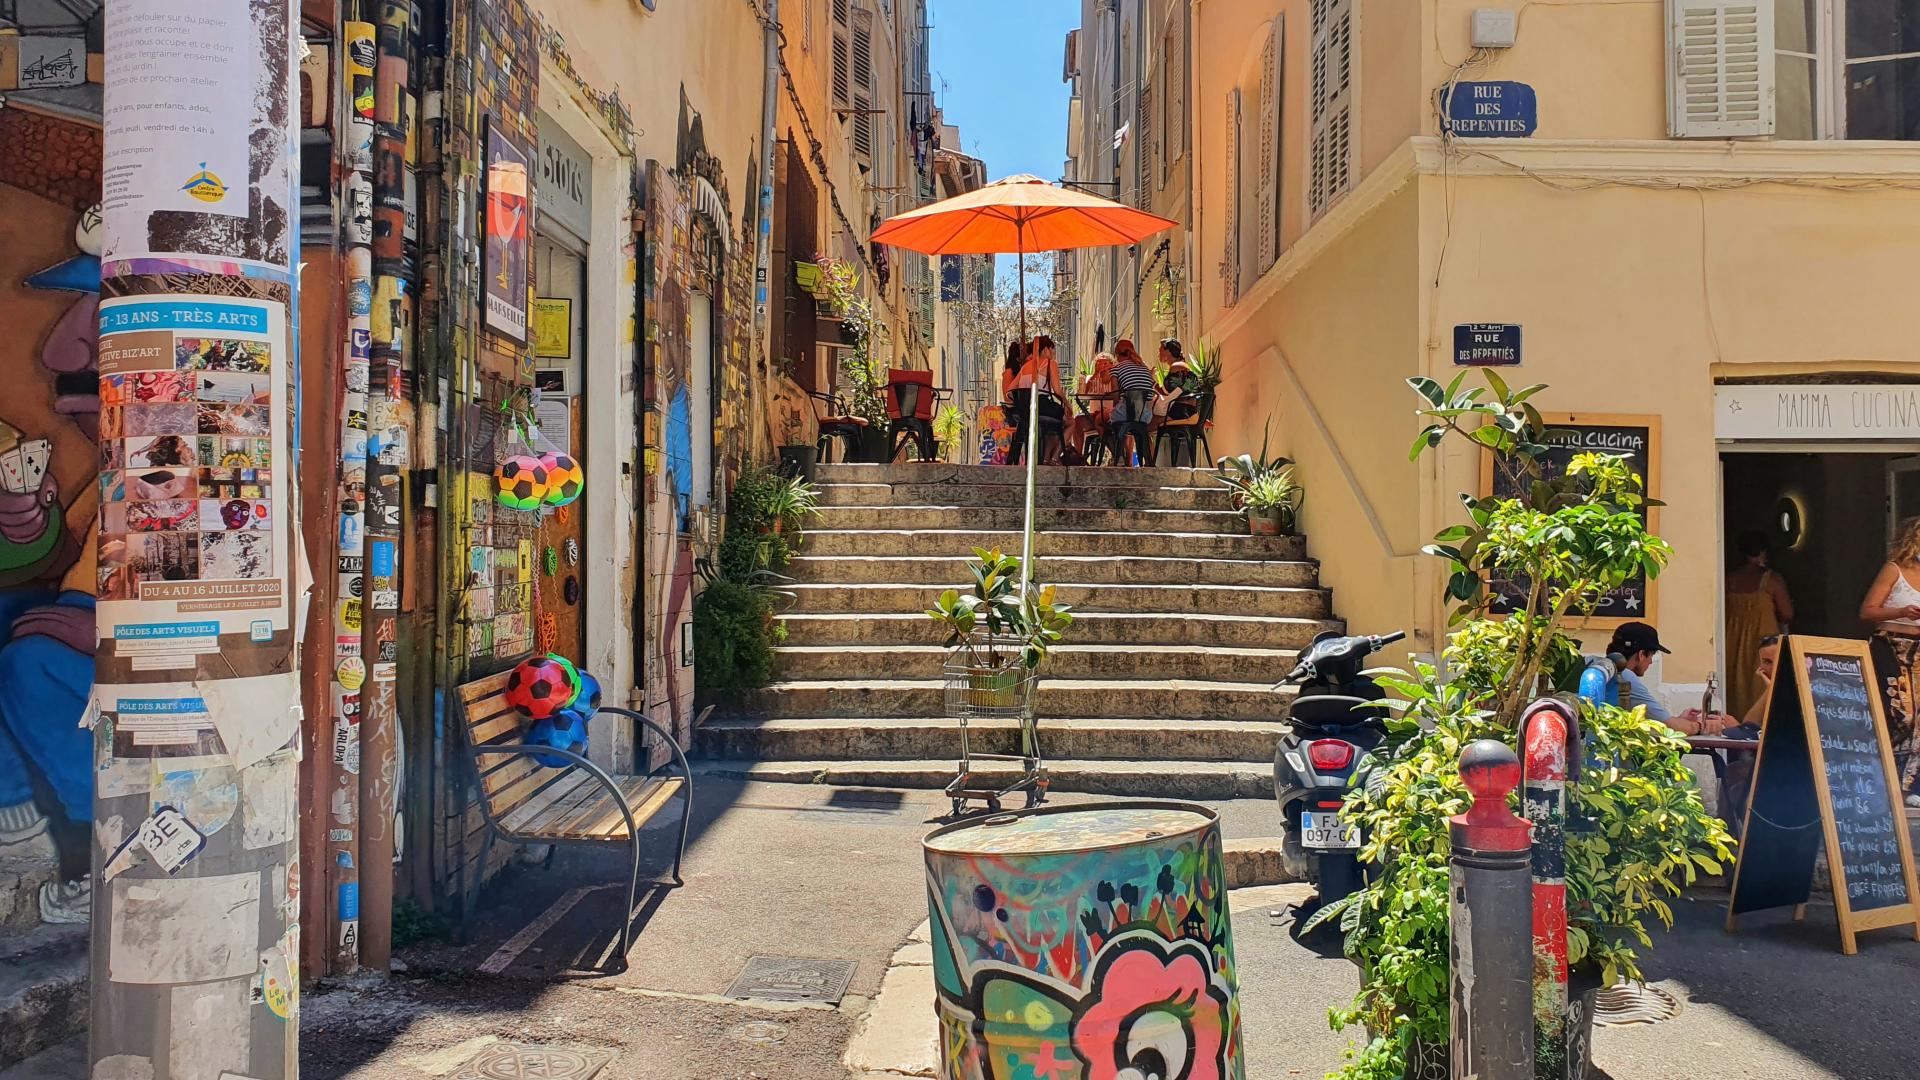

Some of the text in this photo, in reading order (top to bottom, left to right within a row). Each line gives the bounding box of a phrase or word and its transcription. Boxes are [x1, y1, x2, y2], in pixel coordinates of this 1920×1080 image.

[167, 14, 182, 22] sur
[184, 14, 196, 23] du
[198, 16, 228, 28] papier
[154, 27, 191, 35] raconter
[155, 39, 188, 49] occupe
[213, 43, 235, 53] dont
[183, 52, 229, 64] ensemble
[150, 74, 188, 84] prochain
[190, 76, 220, 87] atelier
[1474, 86, 1502, 98] RUE
[136, 102, 154, 111] pour
[1475, 103, 1501, 115] DES
[144, 123, 178, 133] vendredi
[1451, 119, 1526, 132] REPENTIES
[116, 313, 129, 326] 13
[131, 310, 160, 325] ANS
[172, 306, 213, 324] TRÈS
[217, 312, 258, 327] ARTS
[488, 296, 525, 329] MARSEILLE
[1474, 334, 1500, 343] RUE
[122, 347, 161, 359] BIZ'ART
[1460, 350, 1471, 360] DES
[1777, 392, 1832, 428] MAMMA
[143, 583, 280, 597] DU 4 AU 16 JUILLET 2020
[116, 625, 216, 636] PÔLE DES ARTS VISUELS
[119, 701, 138, 710] PÔLE
[138, 701, 154, 710] DES
[155, 701, 178, 710] ARTS
